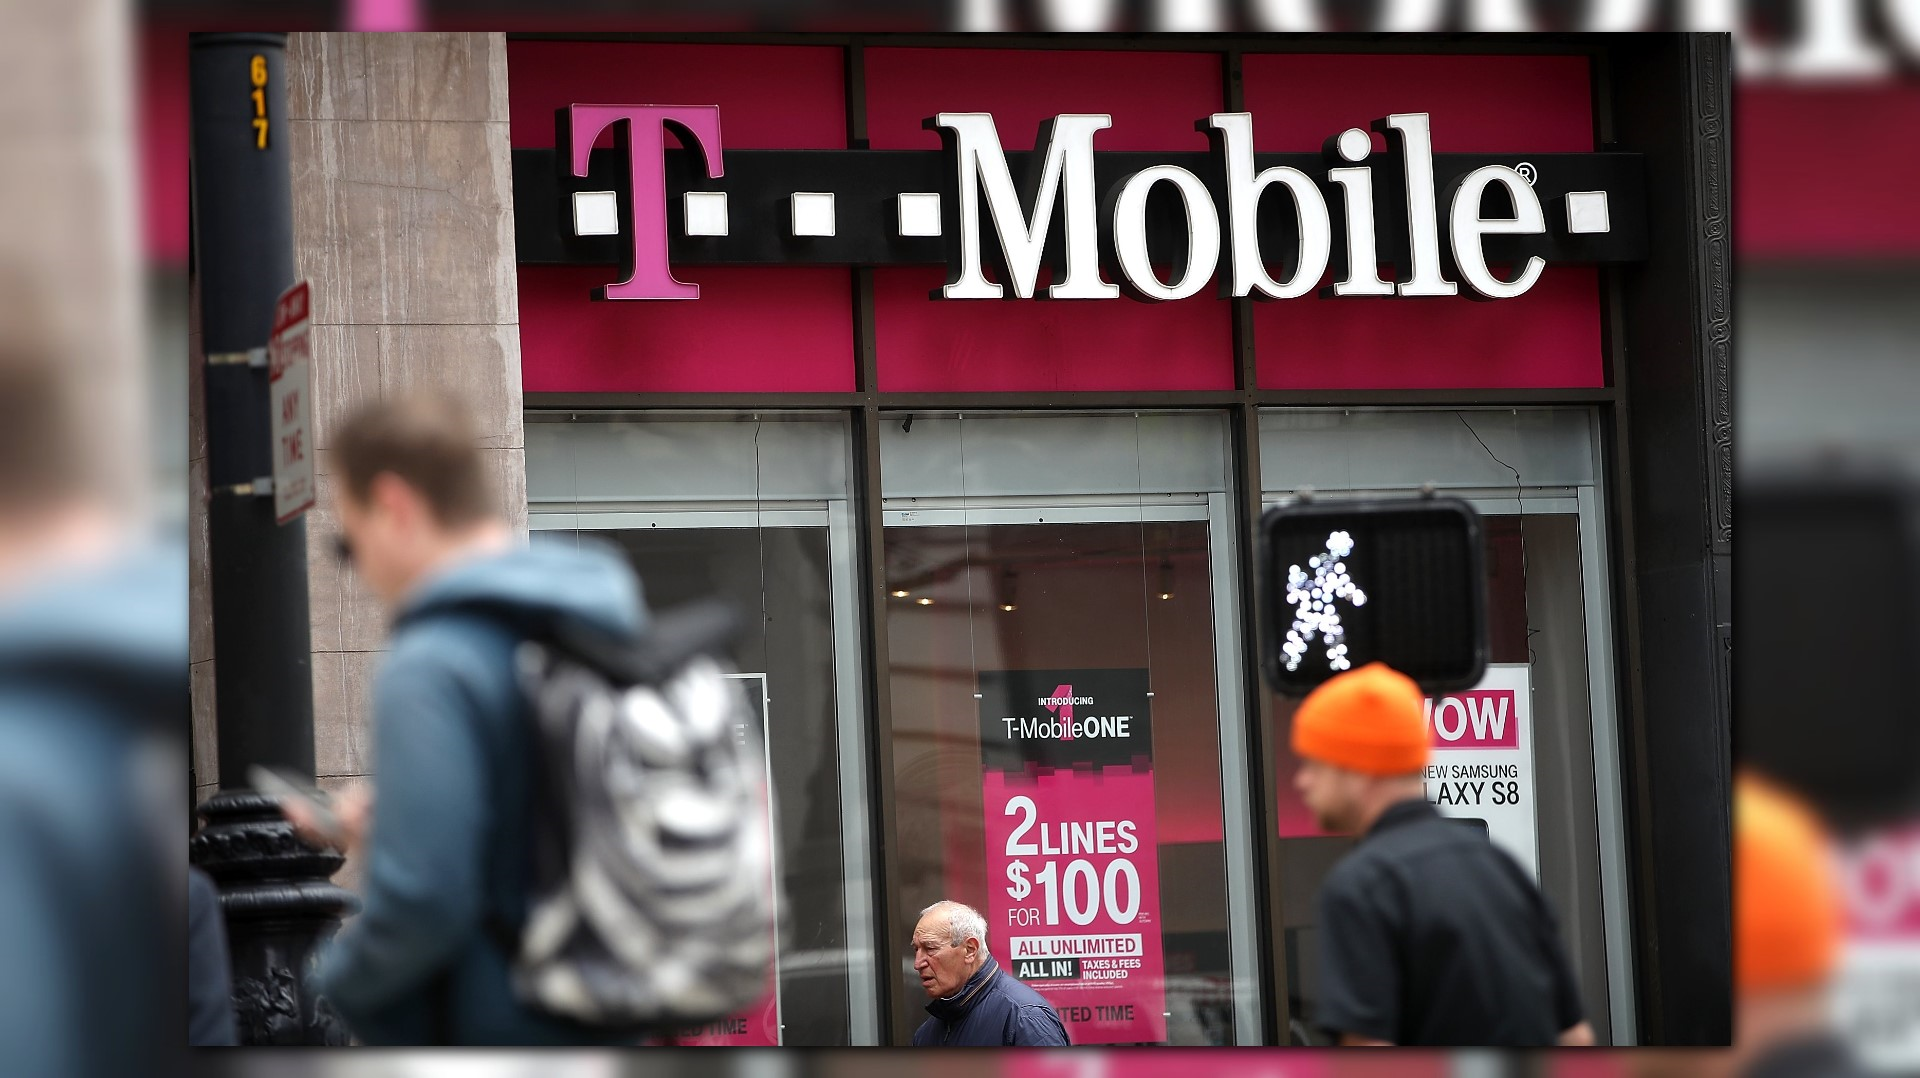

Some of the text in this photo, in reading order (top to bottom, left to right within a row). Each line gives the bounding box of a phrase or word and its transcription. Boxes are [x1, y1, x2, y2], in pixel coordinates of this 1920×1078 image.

[250, 54, 268, 149] 617
[282, 428, 304, 467] TIME
[1038, 697, 1094, 706] INTRODUCING
[1452, 764, 1518, 779] SAMSUNG
[1491, 781, 1520, 806] S8
[1008, 908, 1040, 926] FOR
[1018, 938, 1136, 956] ALL UNLIMITED
[1019, 961, 1073, 978] ALL IN!
[1082, 959, 1142, 970] TAXES & FEES
[1082, 970, 1129, 980] INCLUDED
[1095, 1005, 1135, 1022] TIME
[707, 1018, 748, 1036] TIME
